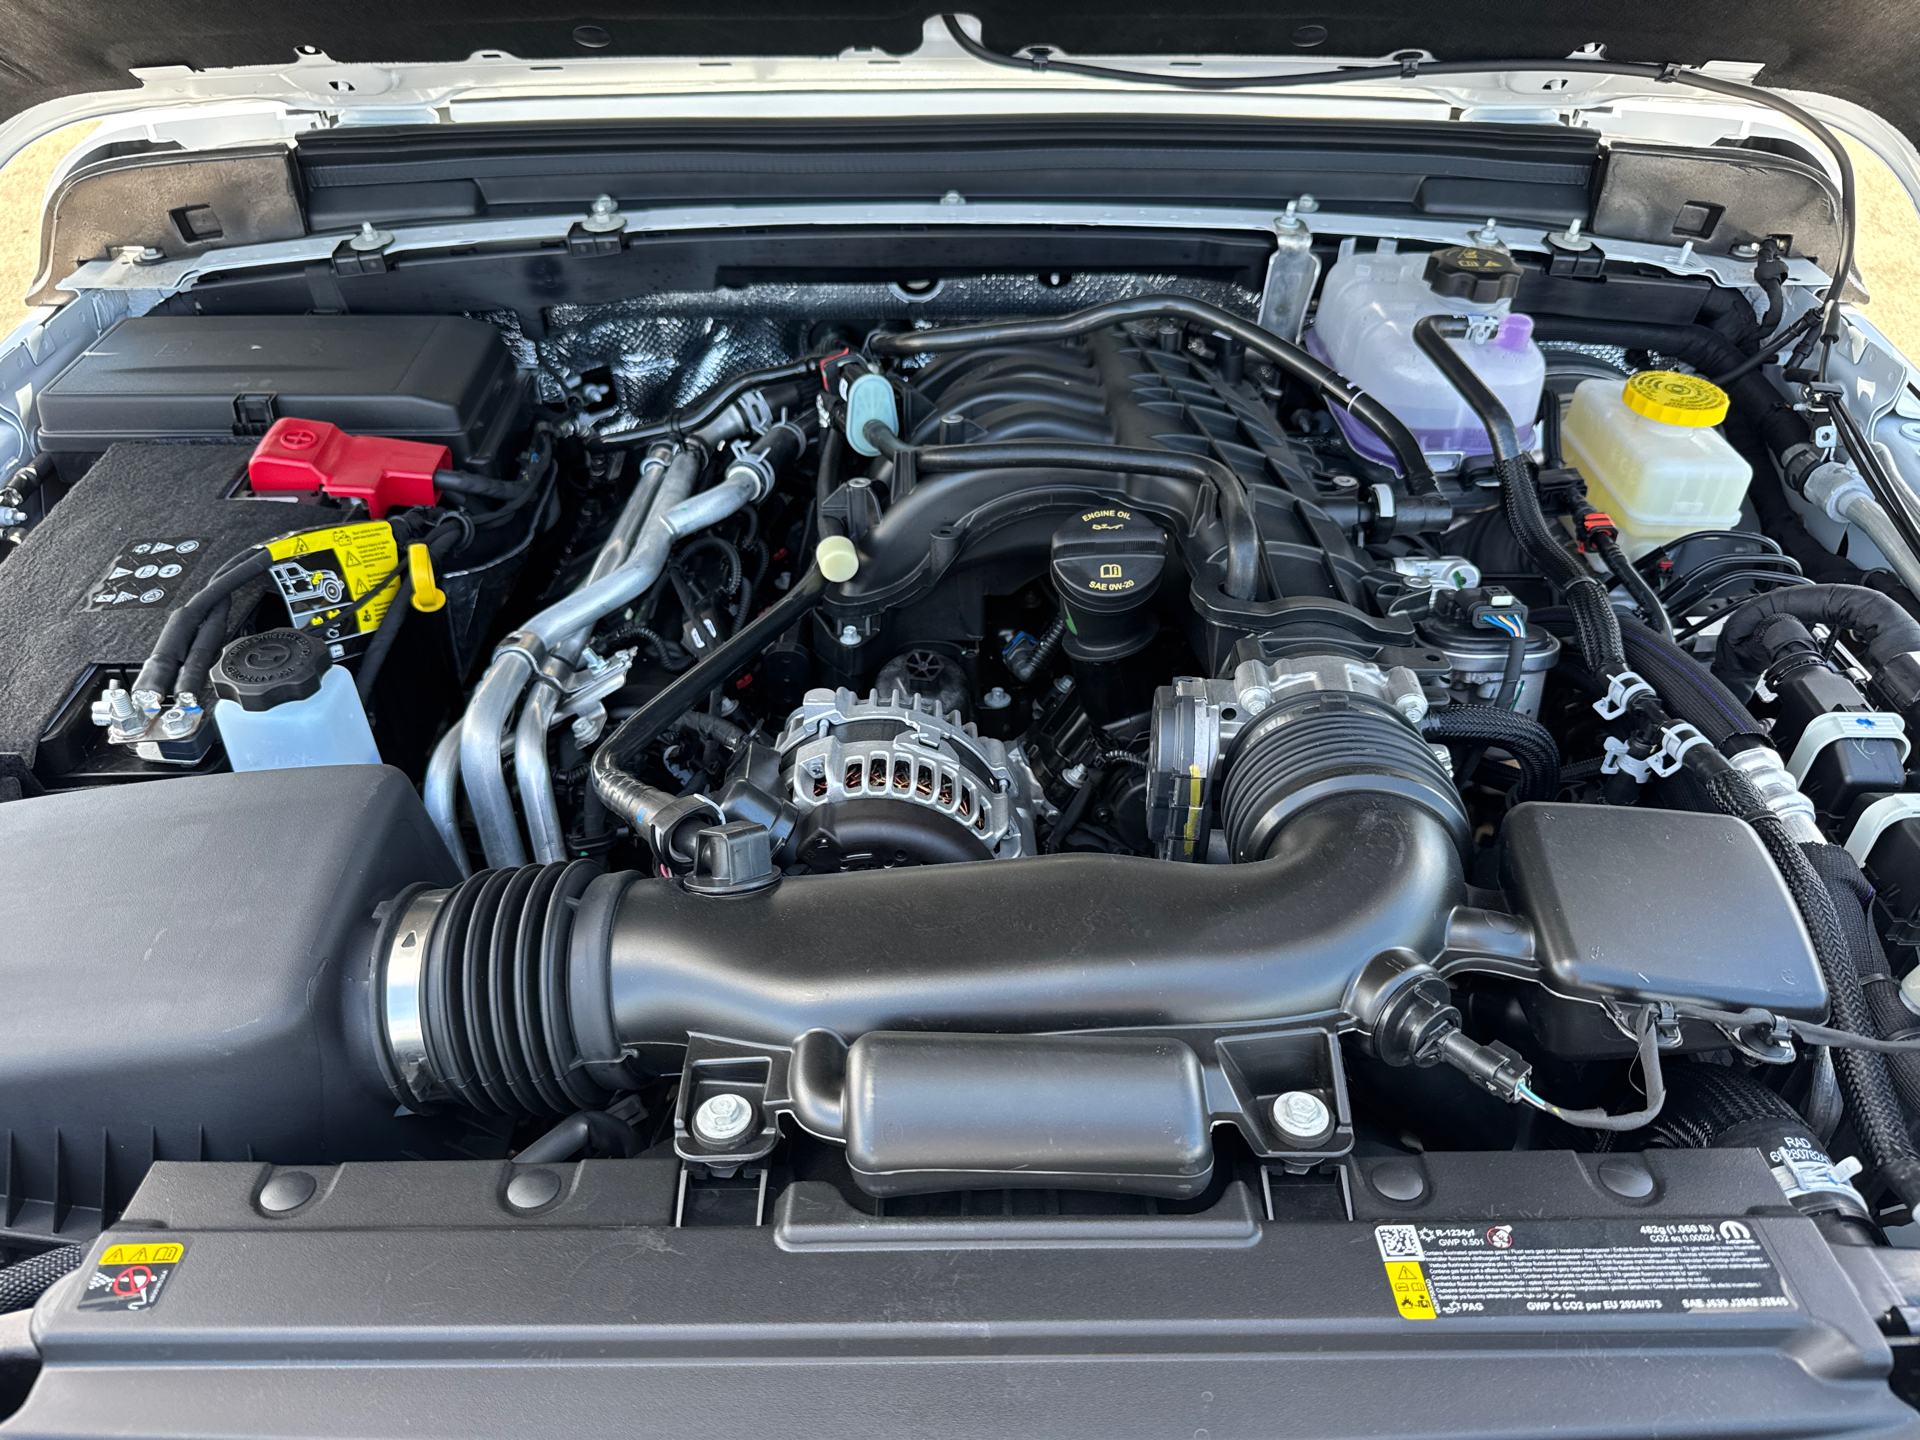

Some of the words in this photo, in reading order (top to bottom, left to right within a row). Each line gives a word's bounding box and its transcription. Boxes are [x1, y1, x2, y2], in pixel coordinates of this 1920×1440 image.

[1082, 510, 1116, 521] ENGINE
[1117, 511, 1131, 520] OIL
[1089, 581, 1107, 590] SAE
[1109, 580, 1134, 590] 0W-20
[227, 666, 272, 682] APPROVED
[1784, 1137, 1811, 1149] RAD
[1435, 1229, 1475, 1238] R-1234yf
[1640, 1225, 1666, 1235] 482g
[1699, 1224, 1714, 1234] lb)
[1438, 1238, 1460, 1246] GWP
[1461, 1238, 1484, 1246] 0.501
[1649, 1234, 1669, 1242] CO2
[1671, 1235, 1682, 1243] eq
[1682, 1233, 1715, 1242] 0.00024
[1462, 1303, 1484, 1311] PAG
[1526, 1302, 1551, 1310] GWP
[1562, 1301, 1584, 1310] CO2
[1602, 1300, 1618, 1309] EU
[1619, 1300, 1663, 1309] 2024/573
[1681, 1299, 1704, 1308] SAE
